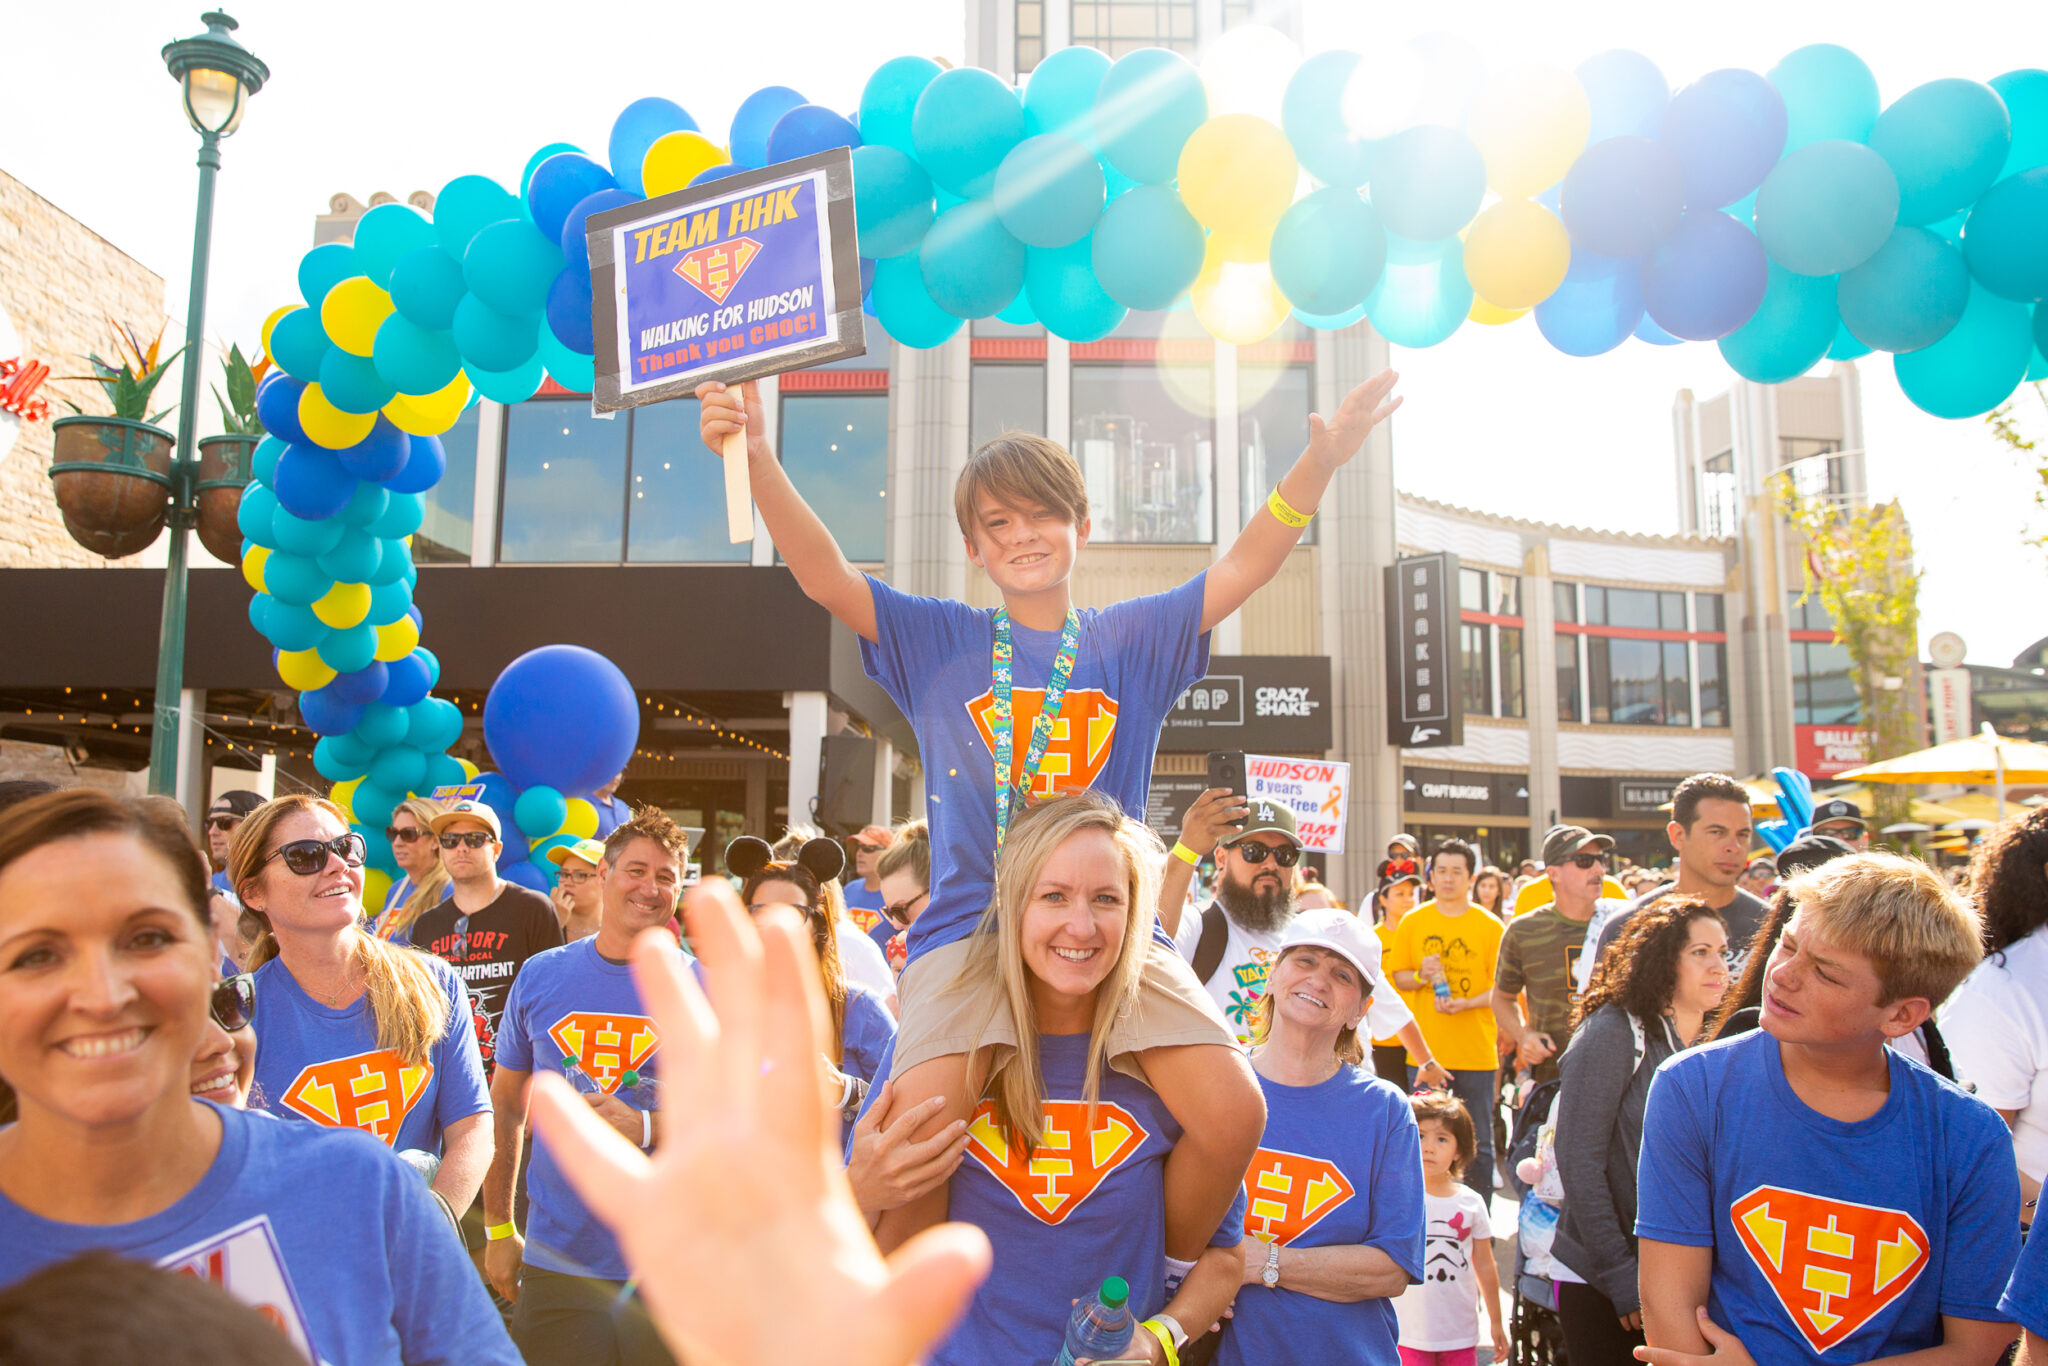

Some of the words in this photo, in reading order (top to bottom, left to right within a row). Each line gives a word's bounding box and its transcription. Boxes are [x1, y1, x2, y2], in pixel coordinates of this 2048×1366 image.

[634, 208, 720, 264] TEAM
[727, 184, 802, 237] HHK
[640, 312, 709, 352] WALKING
[712, 303, 744, 333] FOR
[747, 285, 814, 323] HUDSON
[637, 342, 702, 374] Thank
[705, 332, 745, 358] you
[750, 312, 817, 345] CHOC!
[1177, 689, 1229, 710] TAP
[1255, 687, 1310, 702] CRAZY
[1248, 760, 1335, 782] HUDSON
[1256, 779, 1264, 792] 8
[1267, 782, 1302, 796] years
[1422, 783, 1449, 798] CRAFT
[1449, 785, 1489, 801] BURGERS
[1257, 800, 1275, 822] LA
[1291, 798, 1318, 812] Free
[1297, 822, 1338, 836] AM
[1299, 835, 1328, 848] HK
